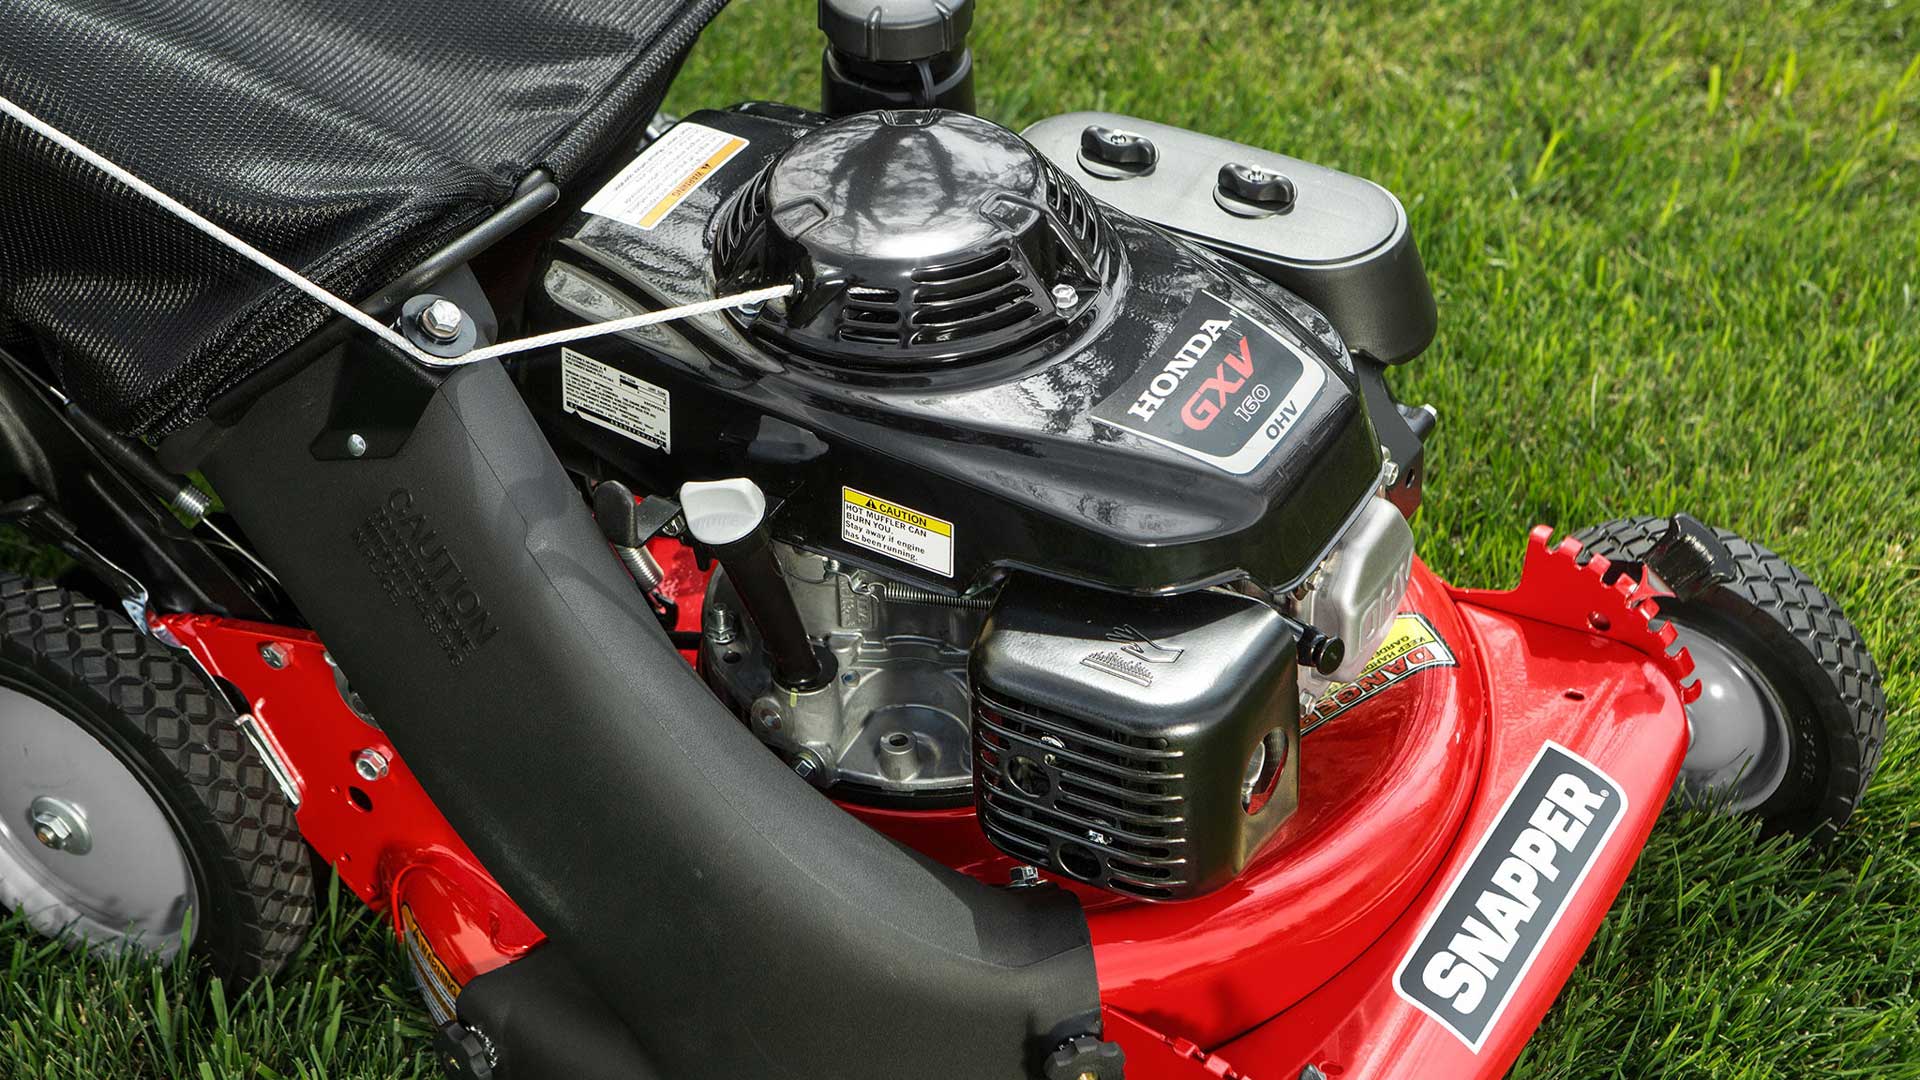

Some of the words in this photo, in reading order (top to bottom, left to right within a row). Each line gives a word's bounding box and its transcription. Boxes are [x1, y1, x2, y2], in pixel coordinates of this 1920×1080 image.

[1127, 319, 1233, 422] HONDA
[1181, 336, 1254, 431] GXV
[1234, 384, 1271, 423] 160
[1265, 400, 1300, 440] OHV
[846, 503, 864, 515] HOT
[866, 510, 906, 531] MUFFLER
[908, 525, 927, 538] CAN
[846, 512, 871, 526] BURN
[873, 521, 894, 535] YOU.
[879, 503, 927, 527] CAUTION
[845, 520, 863, 533] Stay
[866, 529, 886, 541] away
[888, 535, 895, 543] if
[897, 540, 925, 555] engine
[845, 529, 860, 540] has
[862, 535, 882, 547] been
[883, 544, 918, 561] running.
[390, 488, 499, 646] CAUTION
[1422, 772, 1606, 1015] SNAPPER
